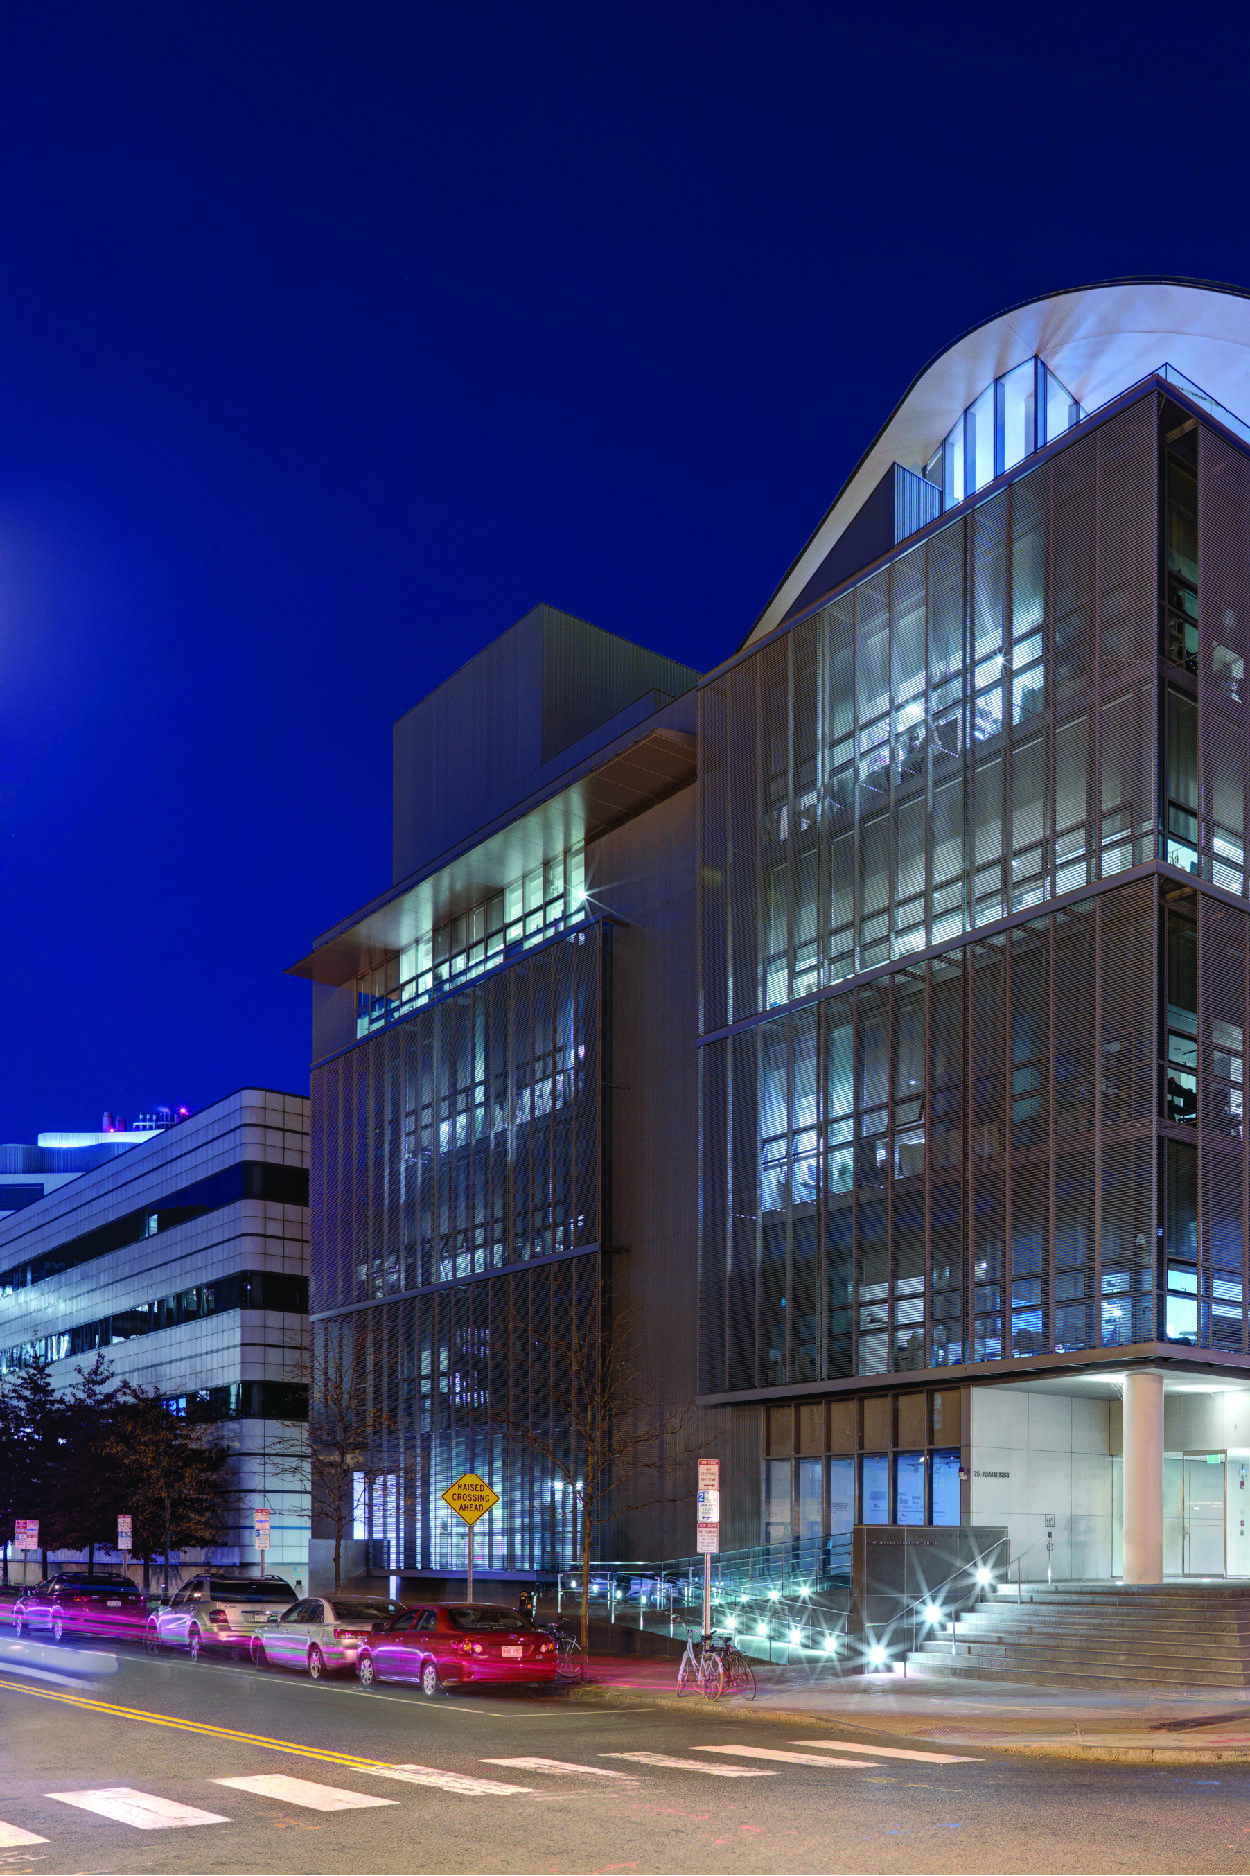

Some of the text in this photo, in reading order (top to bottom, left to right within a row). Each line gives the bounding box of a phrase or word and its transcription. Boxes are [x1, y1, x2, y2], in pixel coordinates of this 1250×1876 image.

[457, 1483, 484, 1491] RAISED
[451, 1493, 489, 1502] CROSSING
[459, 1503, 483, 1511] AHEAD
